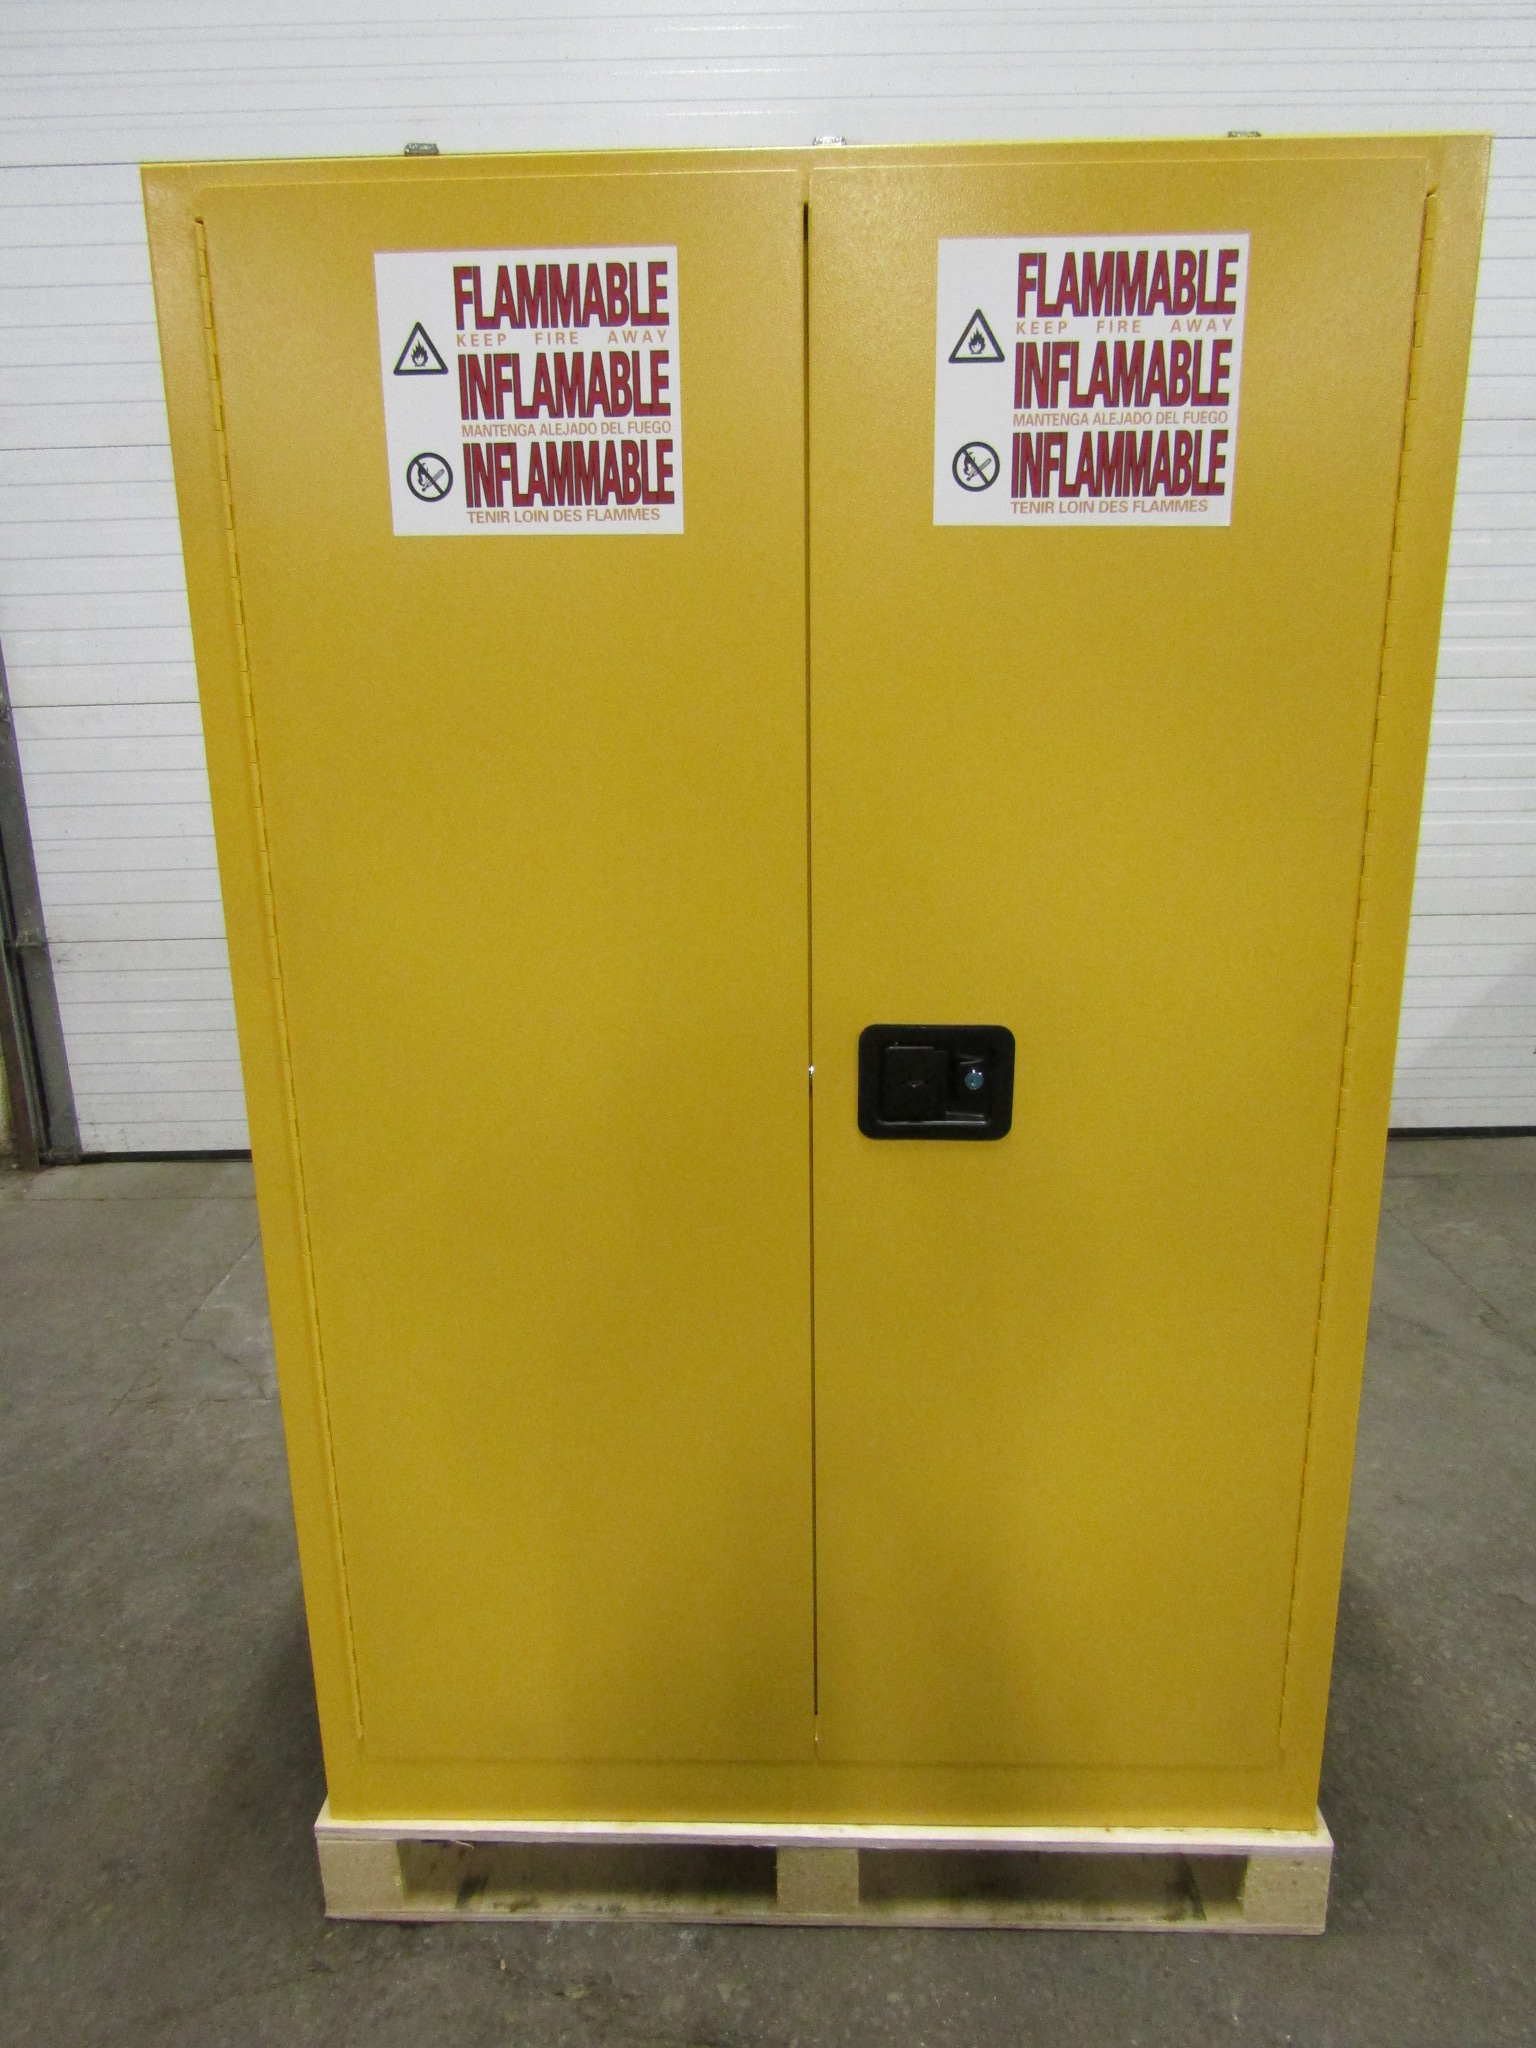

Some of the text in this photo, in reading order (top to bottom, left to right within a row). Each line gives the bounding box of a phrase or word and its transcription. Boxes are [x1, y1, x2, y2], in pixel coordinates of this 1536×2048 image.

[453, 262, 669, 330] FLAMMABLE
[1017, 249, 1239, 317] FLAMMABLE
[457, 330, 668, 347] KEEP FIRE AWAY
[1016, 318, 1233, 335] KEEP FIRE AWAY
[458, 350, 670, 420] INFLAMABLE
[1014, 339, 1232, 409] INFLAMABLE
[462, 421, 671, 437] MANTENGA ALEJADO DEL FUEGO
[1013, 411, 1227, 427] MANTENGA ALEJADO DEL FUEGO
[463, 439, 674, 508] INFLAMMABLE
[1011, 430, 1228, 498] INFLAMMABLE
[467, 508, 660, 524] TENIR LOIN DES FLAMMES
[1011, 498, 1208, 514] TENIR LOIN DES FLAMMES
